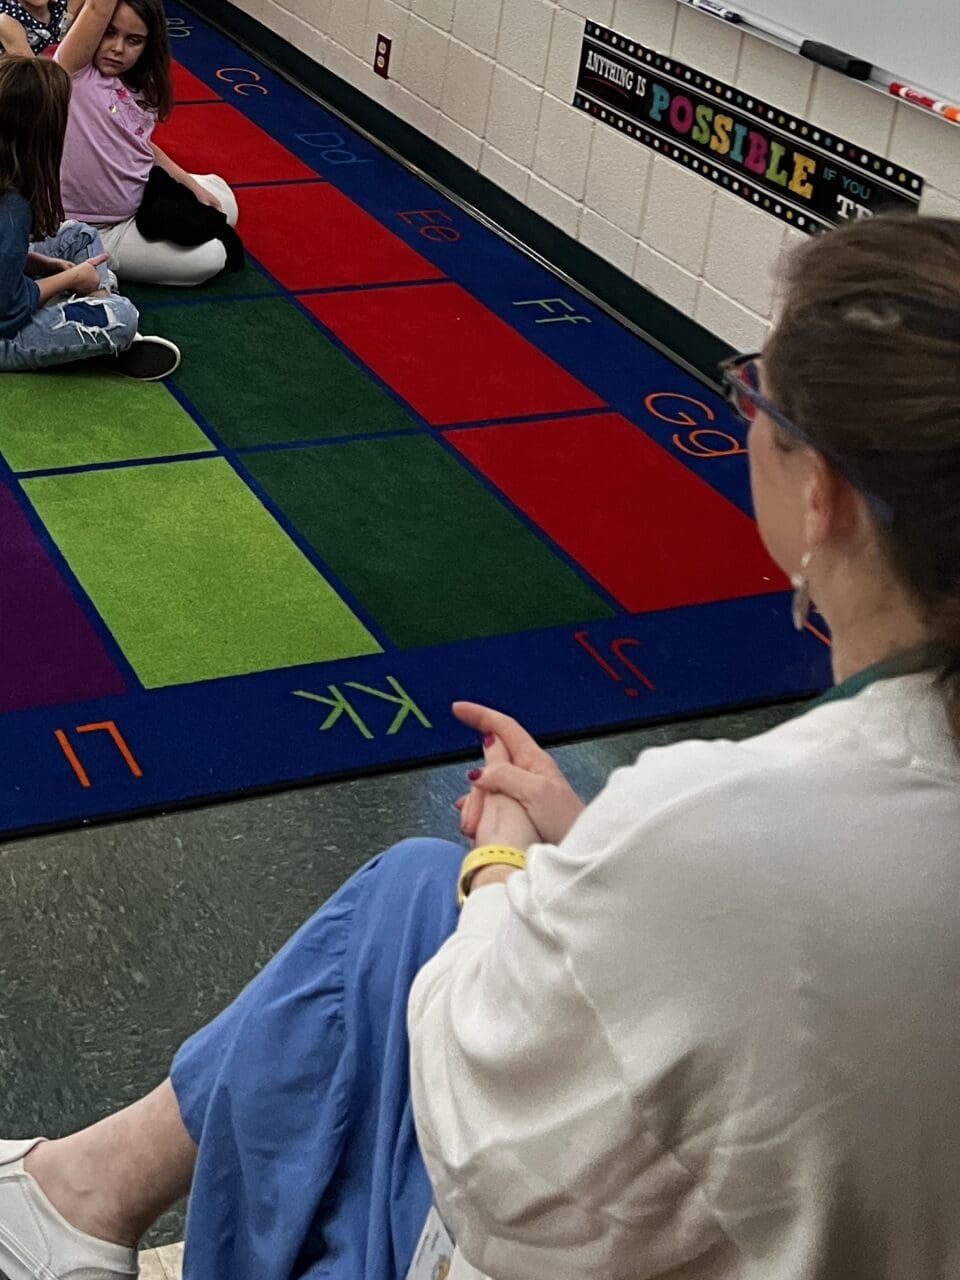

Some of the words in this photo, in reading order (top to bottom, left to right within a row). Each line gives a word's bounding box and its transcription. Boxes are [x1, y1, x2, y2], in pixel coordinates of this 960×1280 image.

[215, 67, 268, 96] Cc
[585, 50, 633, 90] ANYTHING
[636, 76, 646, 98] IS
[647, 83, 816, 200] POSSIBLE
[293, 131, 376, 165] Dd
[822, 167, 838, 181] IF
[841, 175, 872, 200] YOU
[396, 209, 461, 243] Ee
[512, 297, 593, 325] Ff
[644, 392, 752, 458] Gg
